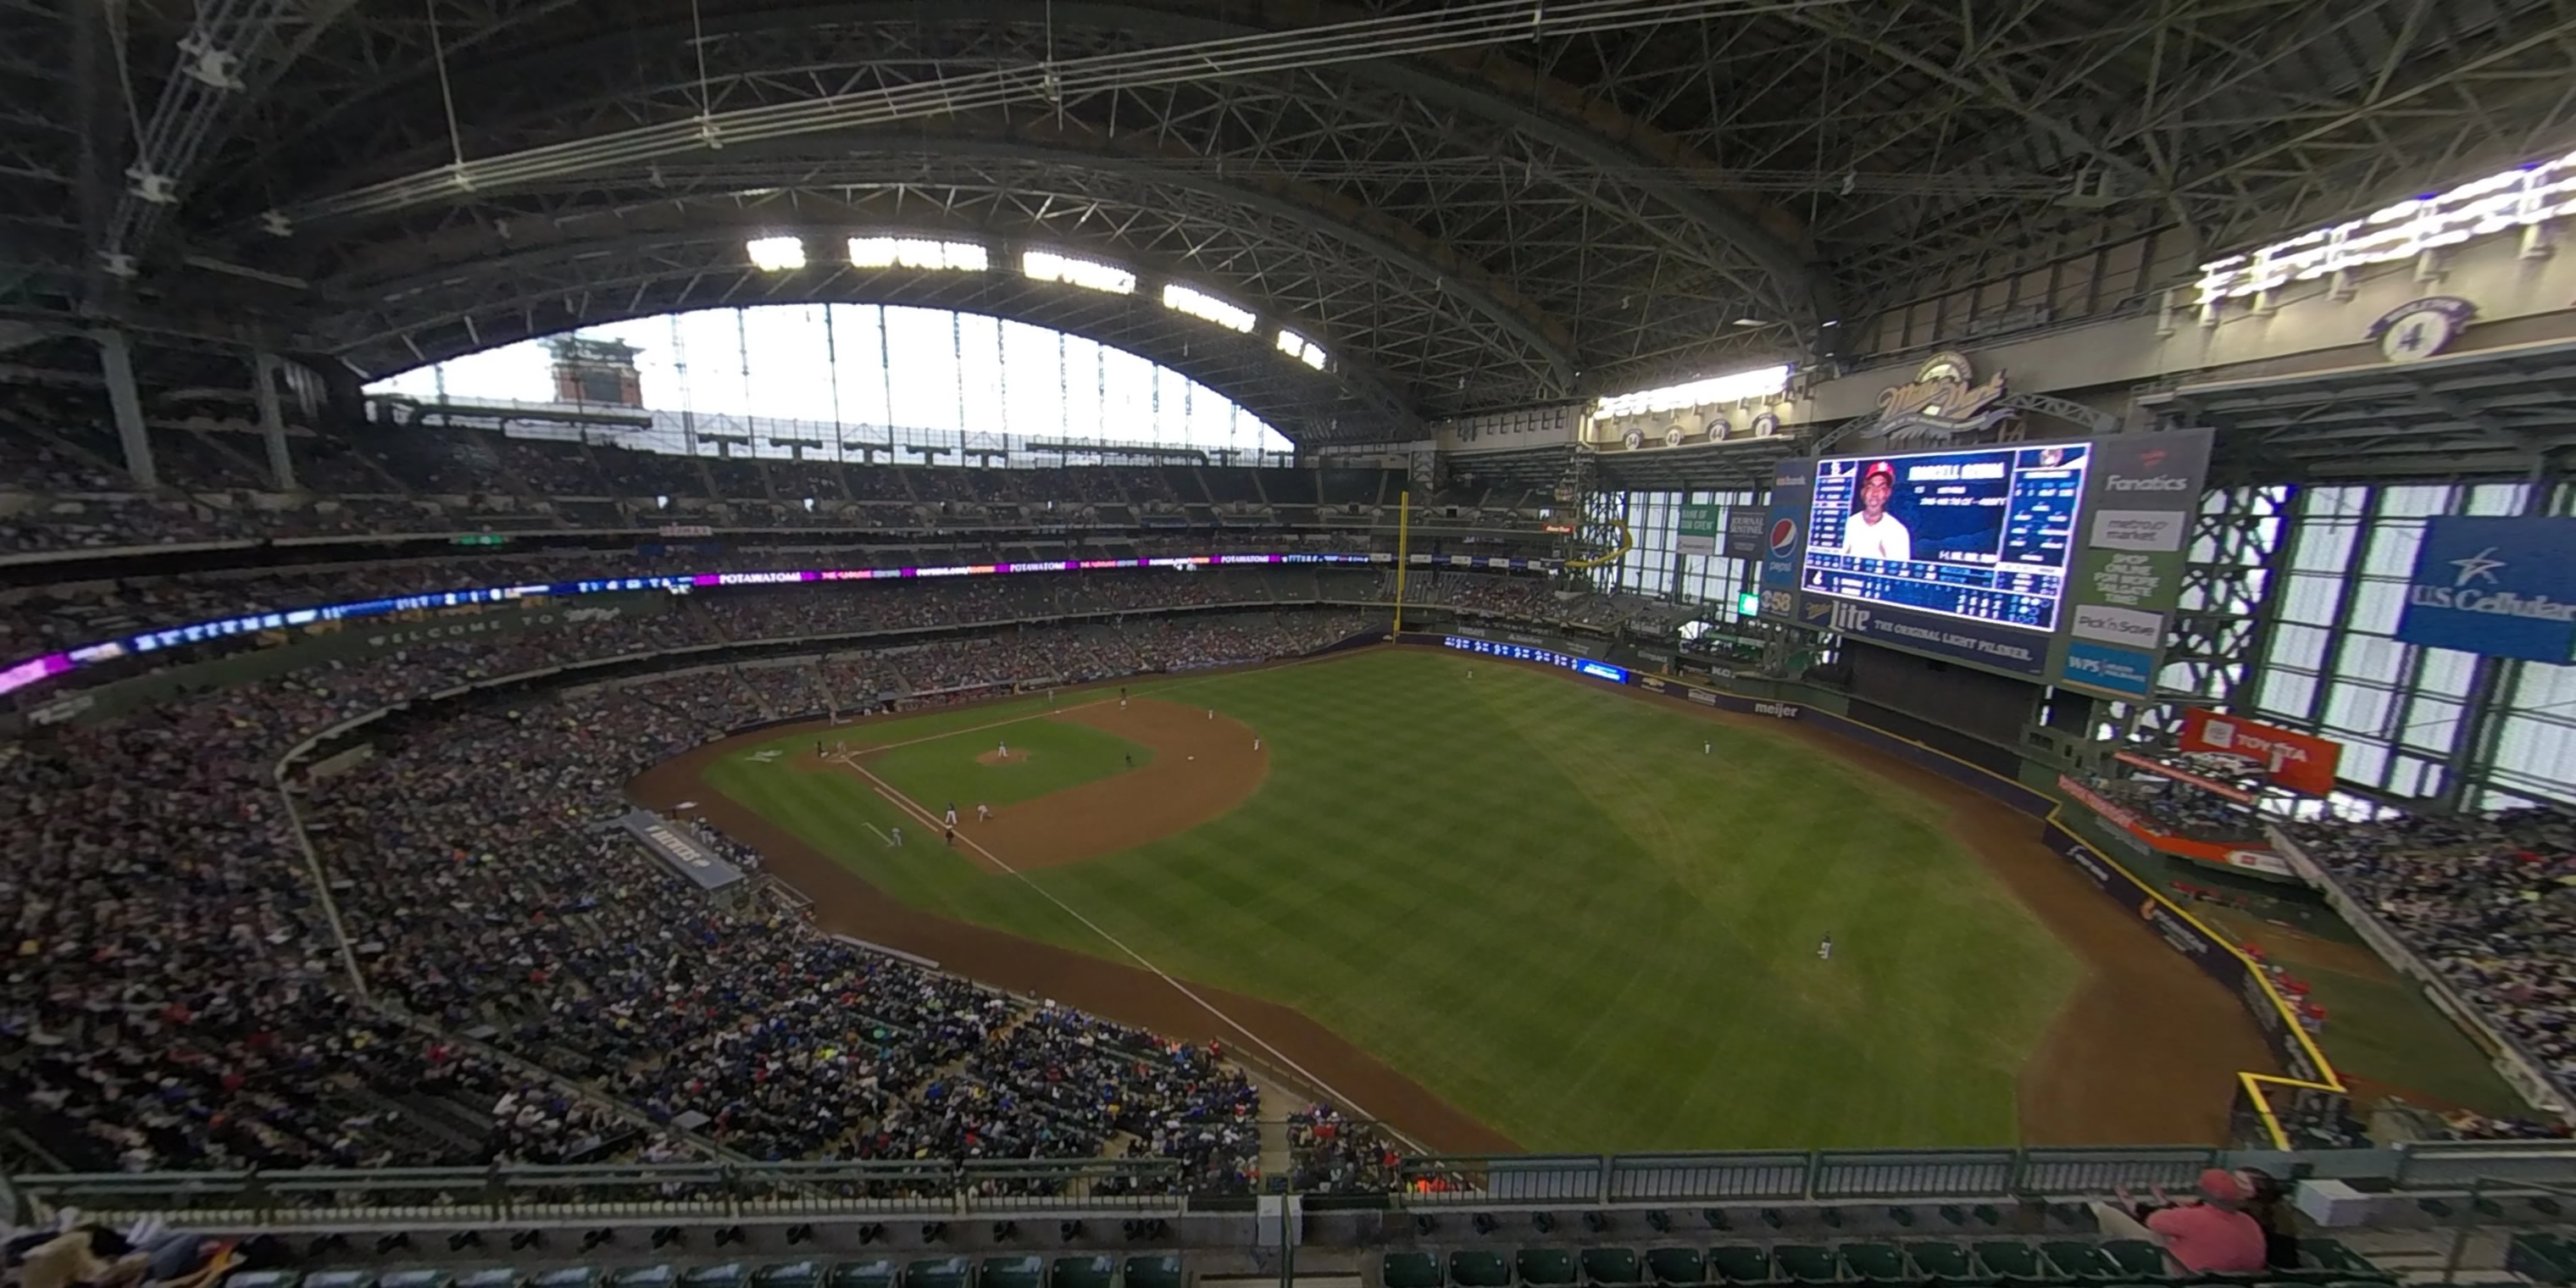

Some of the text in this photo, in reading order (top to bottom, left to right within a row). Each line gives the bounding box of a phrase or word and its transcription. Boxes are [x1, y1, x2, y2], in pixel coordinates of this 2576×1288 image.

[2396, 322, 2424, 352] 4
[2105, 475, 2188, 491] Fanatics
[1729, 525, 1764, 535] SENTINEL
[1730, 517, 1764, 527] JOURNAL
[720, 572, 802, 585] POTAWATOMI
[1829, 600, 1870, 632] Lite
[368, 620, 501, 647] WELCOME
[2068, 656, 2101, 673] WPS
[1755, 702, 1799, 719] meijer
